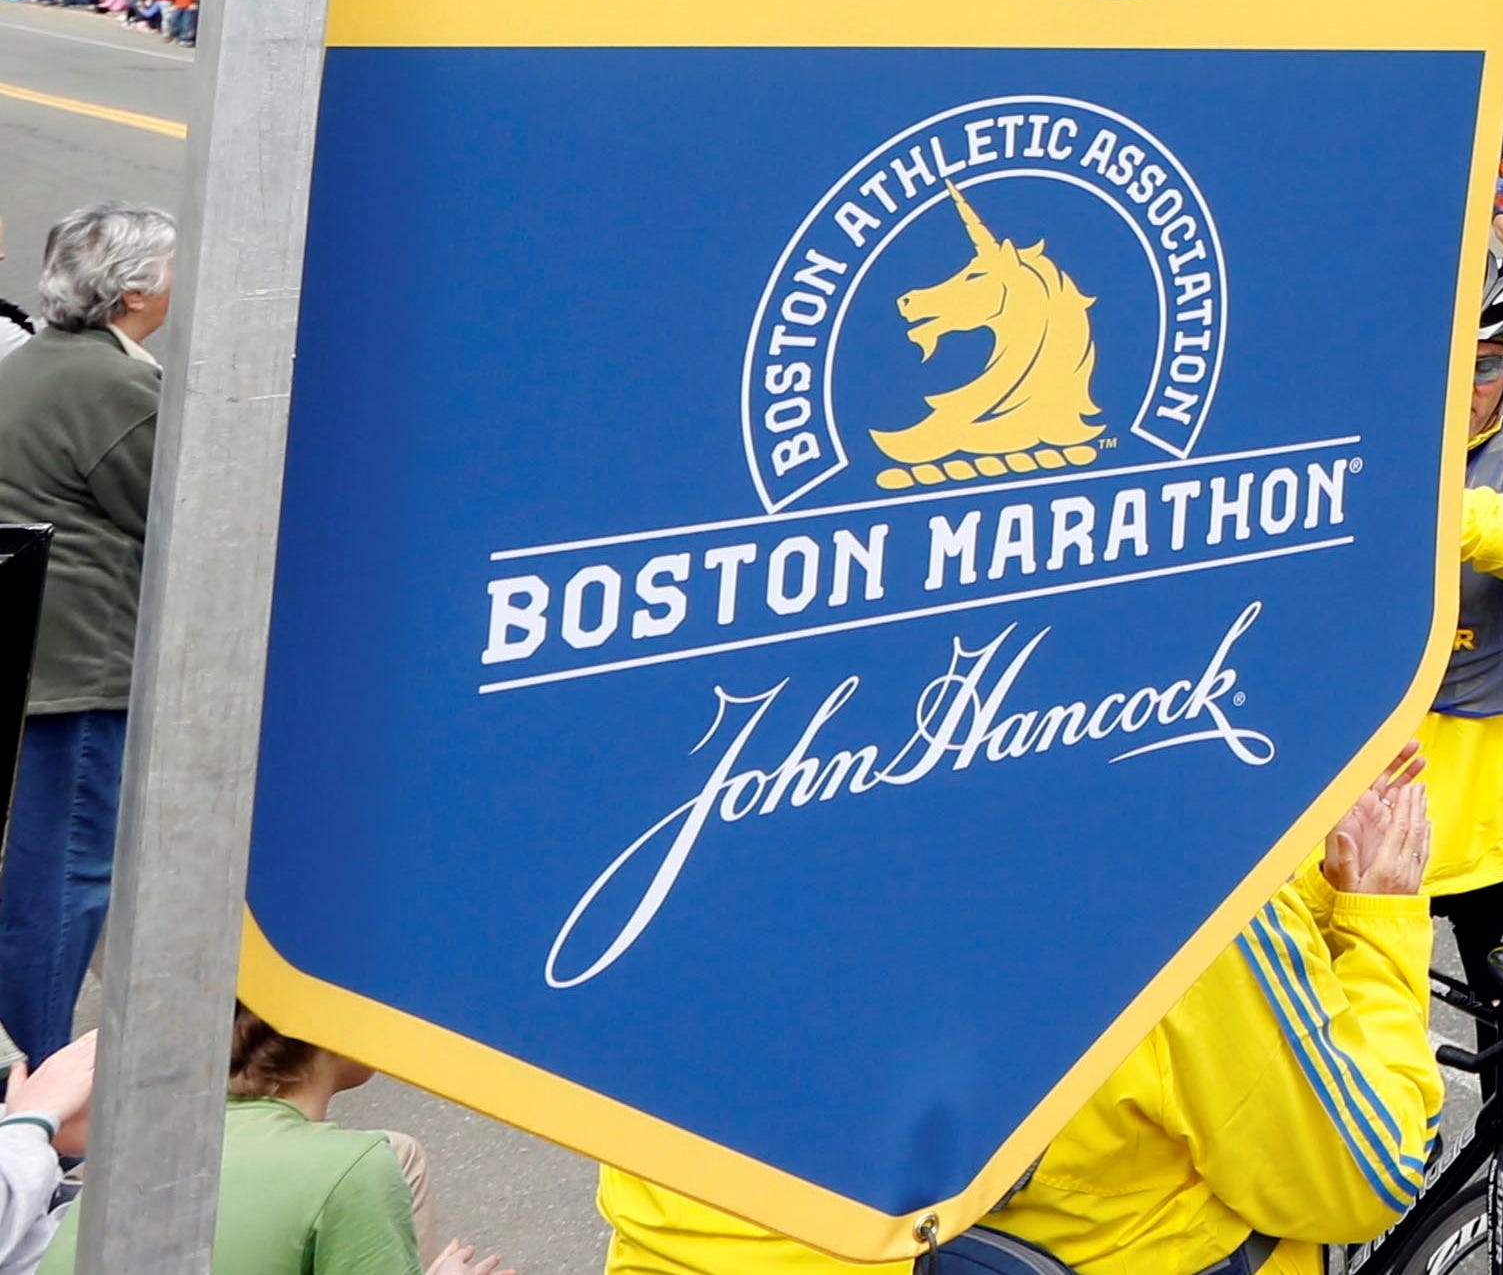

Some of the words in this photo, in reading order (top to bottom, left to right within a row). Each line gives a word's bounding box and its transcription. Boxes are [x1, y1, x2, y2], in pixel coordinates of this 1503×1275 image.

[764, 249, 847, 477] BOSTON
[834, 114, 1078, 247] ATHLETIC
[1080, 130, 1213, 425] ASSOCIATION
[481, 523, 889, 664] BOSTON
[545, 675, 880, 989] John
